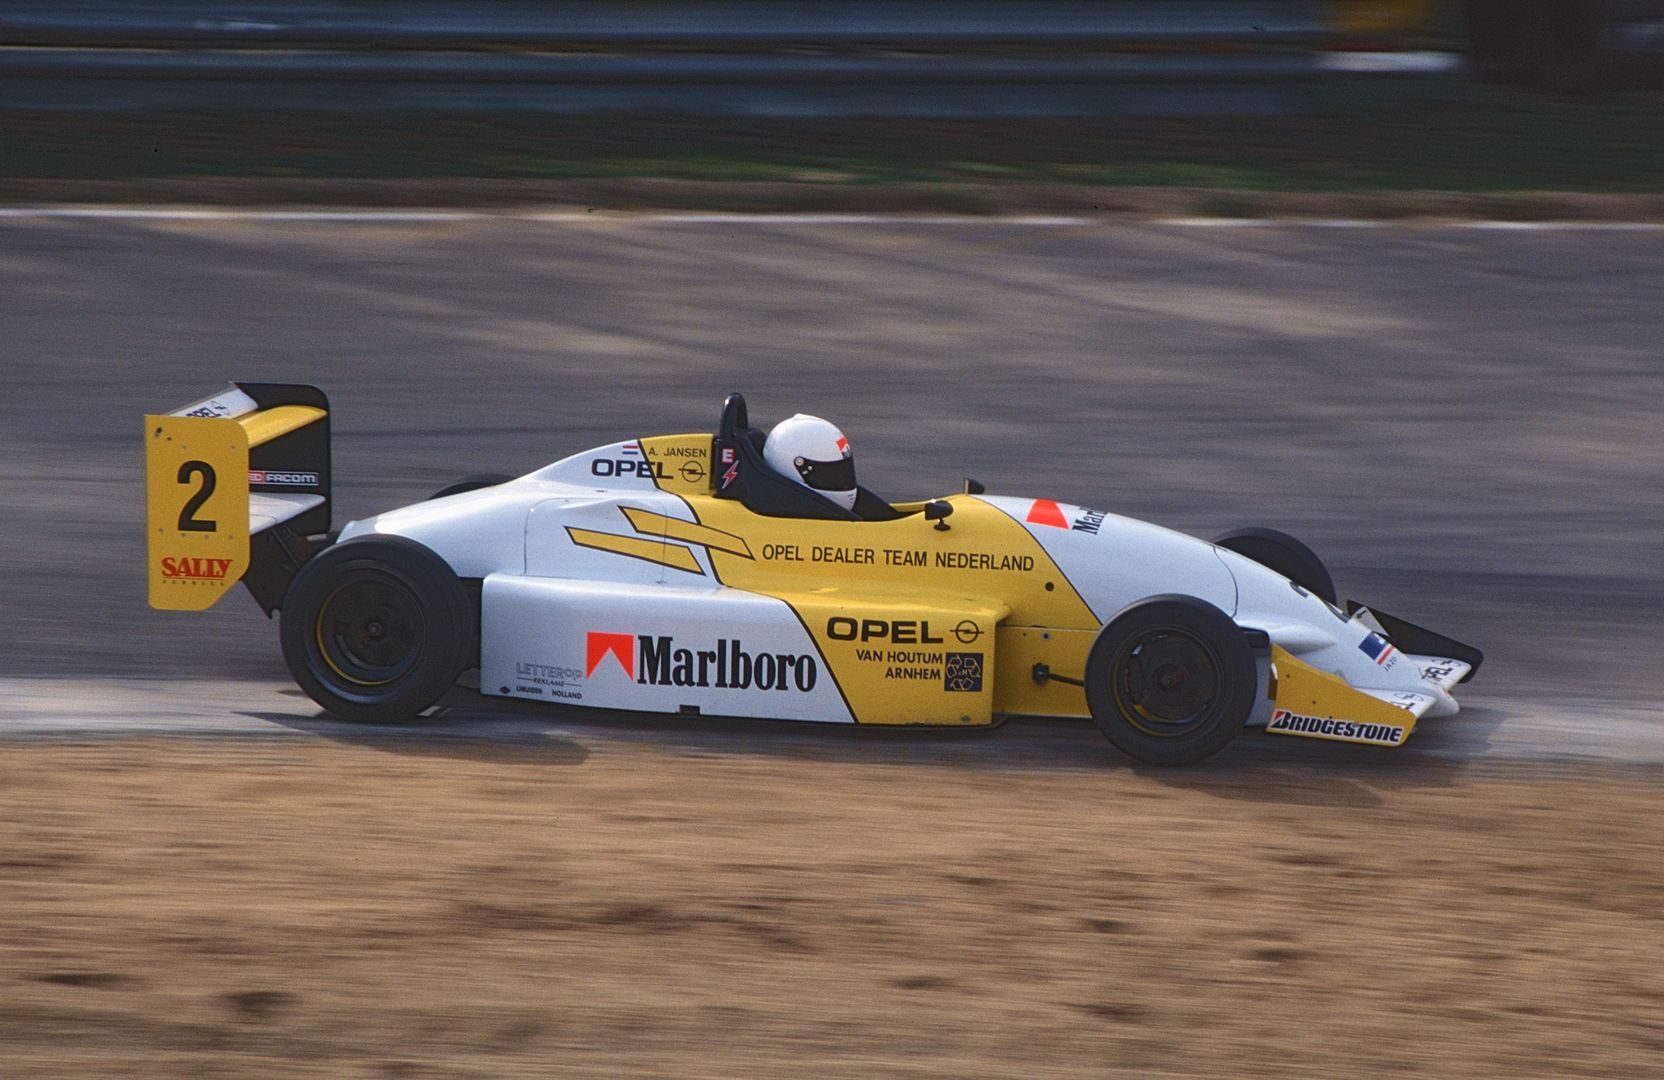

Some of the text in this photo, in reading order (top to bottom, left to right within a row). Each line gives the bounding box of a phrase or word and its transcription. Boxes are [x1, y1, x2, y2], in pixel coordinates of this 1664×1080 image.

[647, 446, 707, 458] A. JANSEN
[721, 447, 735, 464] E
[265, 473, 317, 483] FACOM
[591, 458, 674, 480] OPEL
[176, 460, 217, 533] 2
[160, 556, 234, 578] SALLY
[762, 543, 1035, 572] OPEL DEALER TEAM NEDERLAND
[826, 616, 944, 644] OPEL
[637, 634, 818, 692] Marlboro
[855, 649, 943, 665] VAN HOUTUM
[884, 667, 941, 681] ARNHEM
[551, 688, 583, 700] HOLLAND
[1270, 711, 1403, 743] BRIDGESTONE
